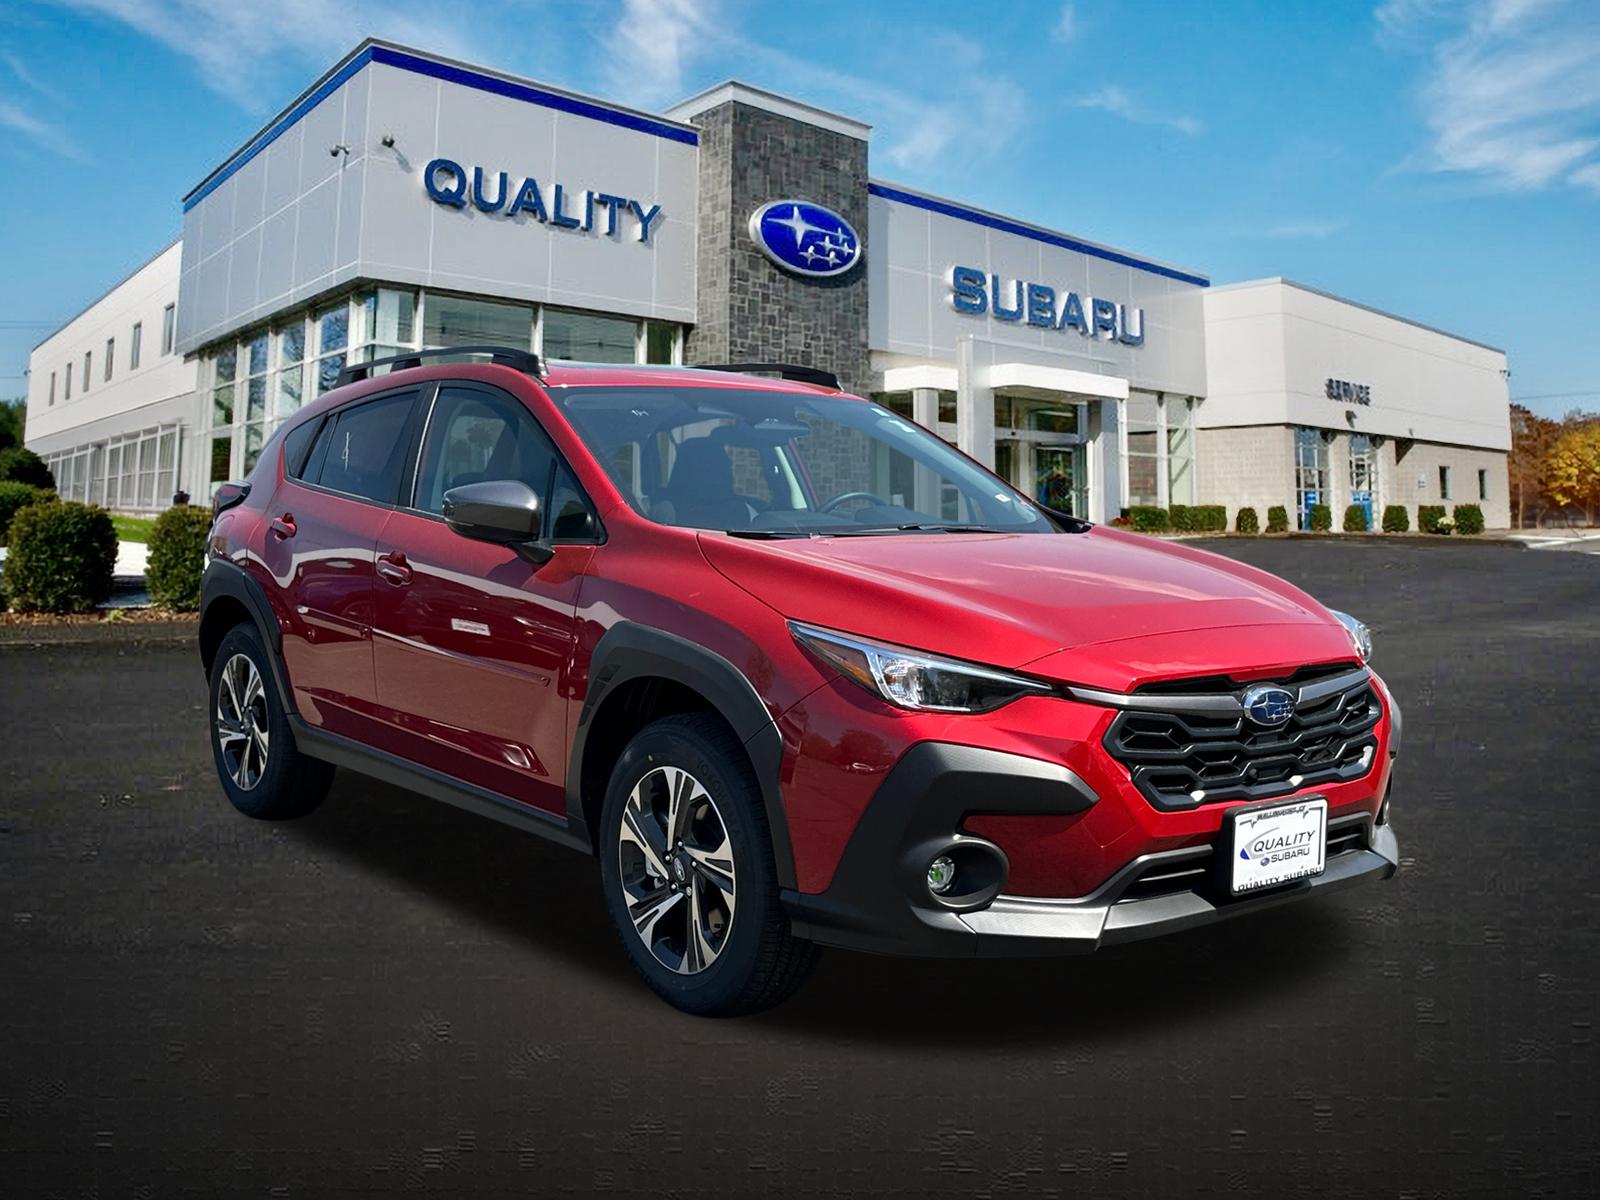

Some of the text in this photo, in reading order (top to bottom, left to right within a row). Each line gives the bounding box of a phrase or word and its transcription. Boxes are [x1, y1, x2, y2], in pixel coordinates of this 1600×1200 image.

[424, 158, 661, 242] QUALITY
[951, 266, 1145, 346] SUBARU
[1254, 830, 1316, 852] QUALITY
[1271, 847, 1310, 863] SUBARU
[1238, 866, 1322, 892] QUALITY SUBARU
